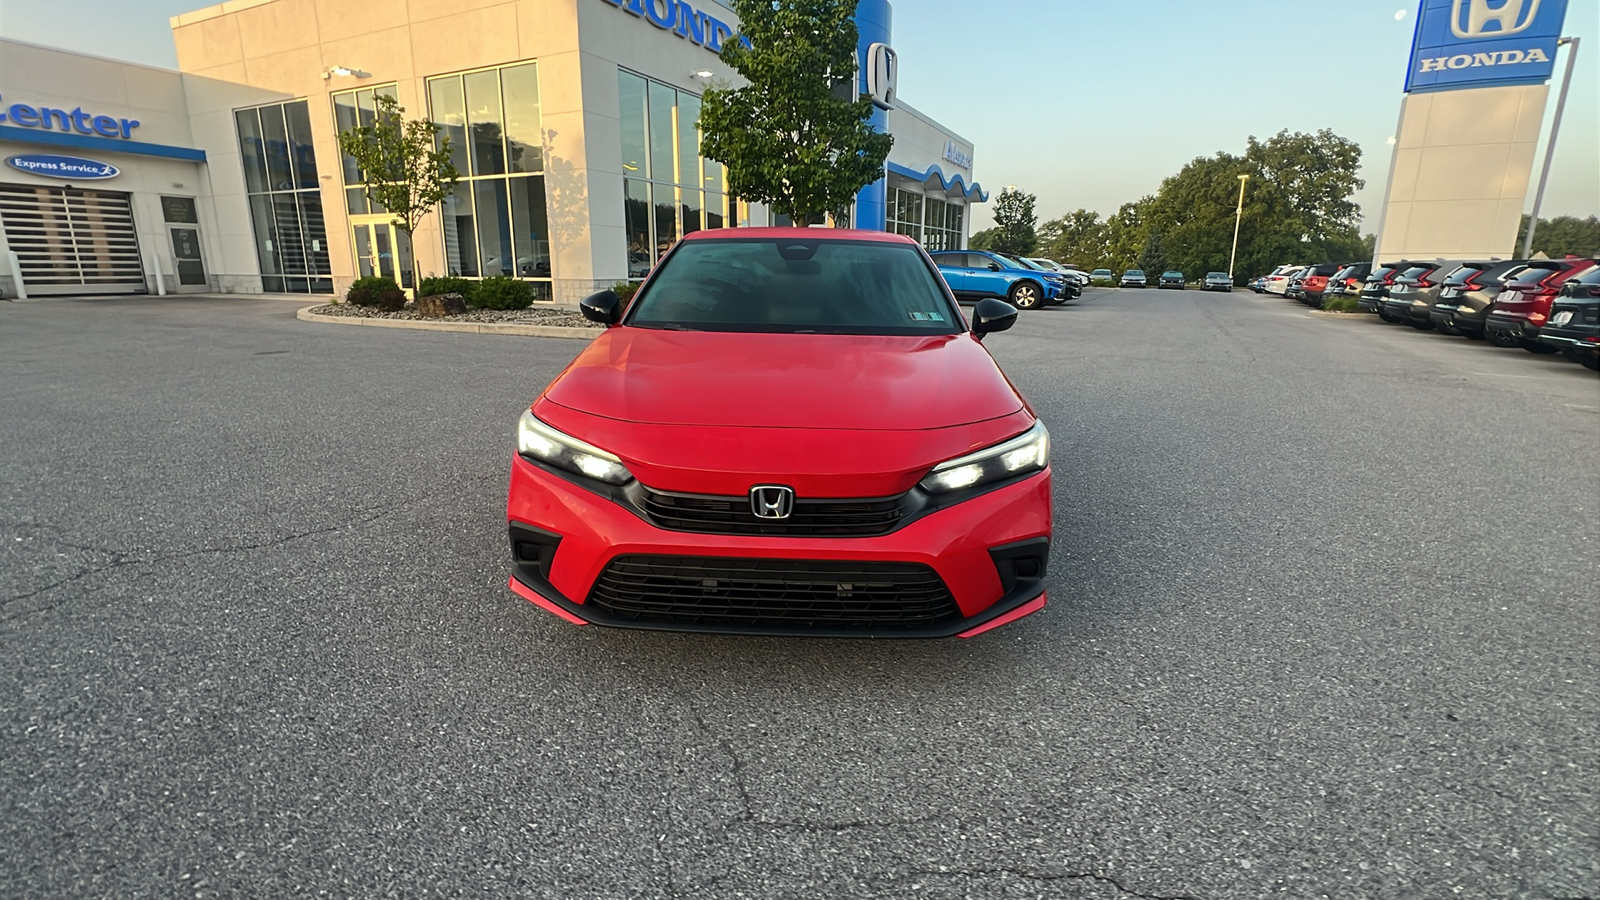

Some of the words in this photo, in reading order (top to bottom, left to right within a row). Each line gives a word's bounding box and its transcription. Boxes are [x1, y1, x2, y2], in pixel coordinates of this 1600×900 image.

[1419, 48, 1549, 73] HONDA
[0, 94, 140, 139] enter
[14, 158, 58, 170] Express
[59, 162, 99, 174] Service
